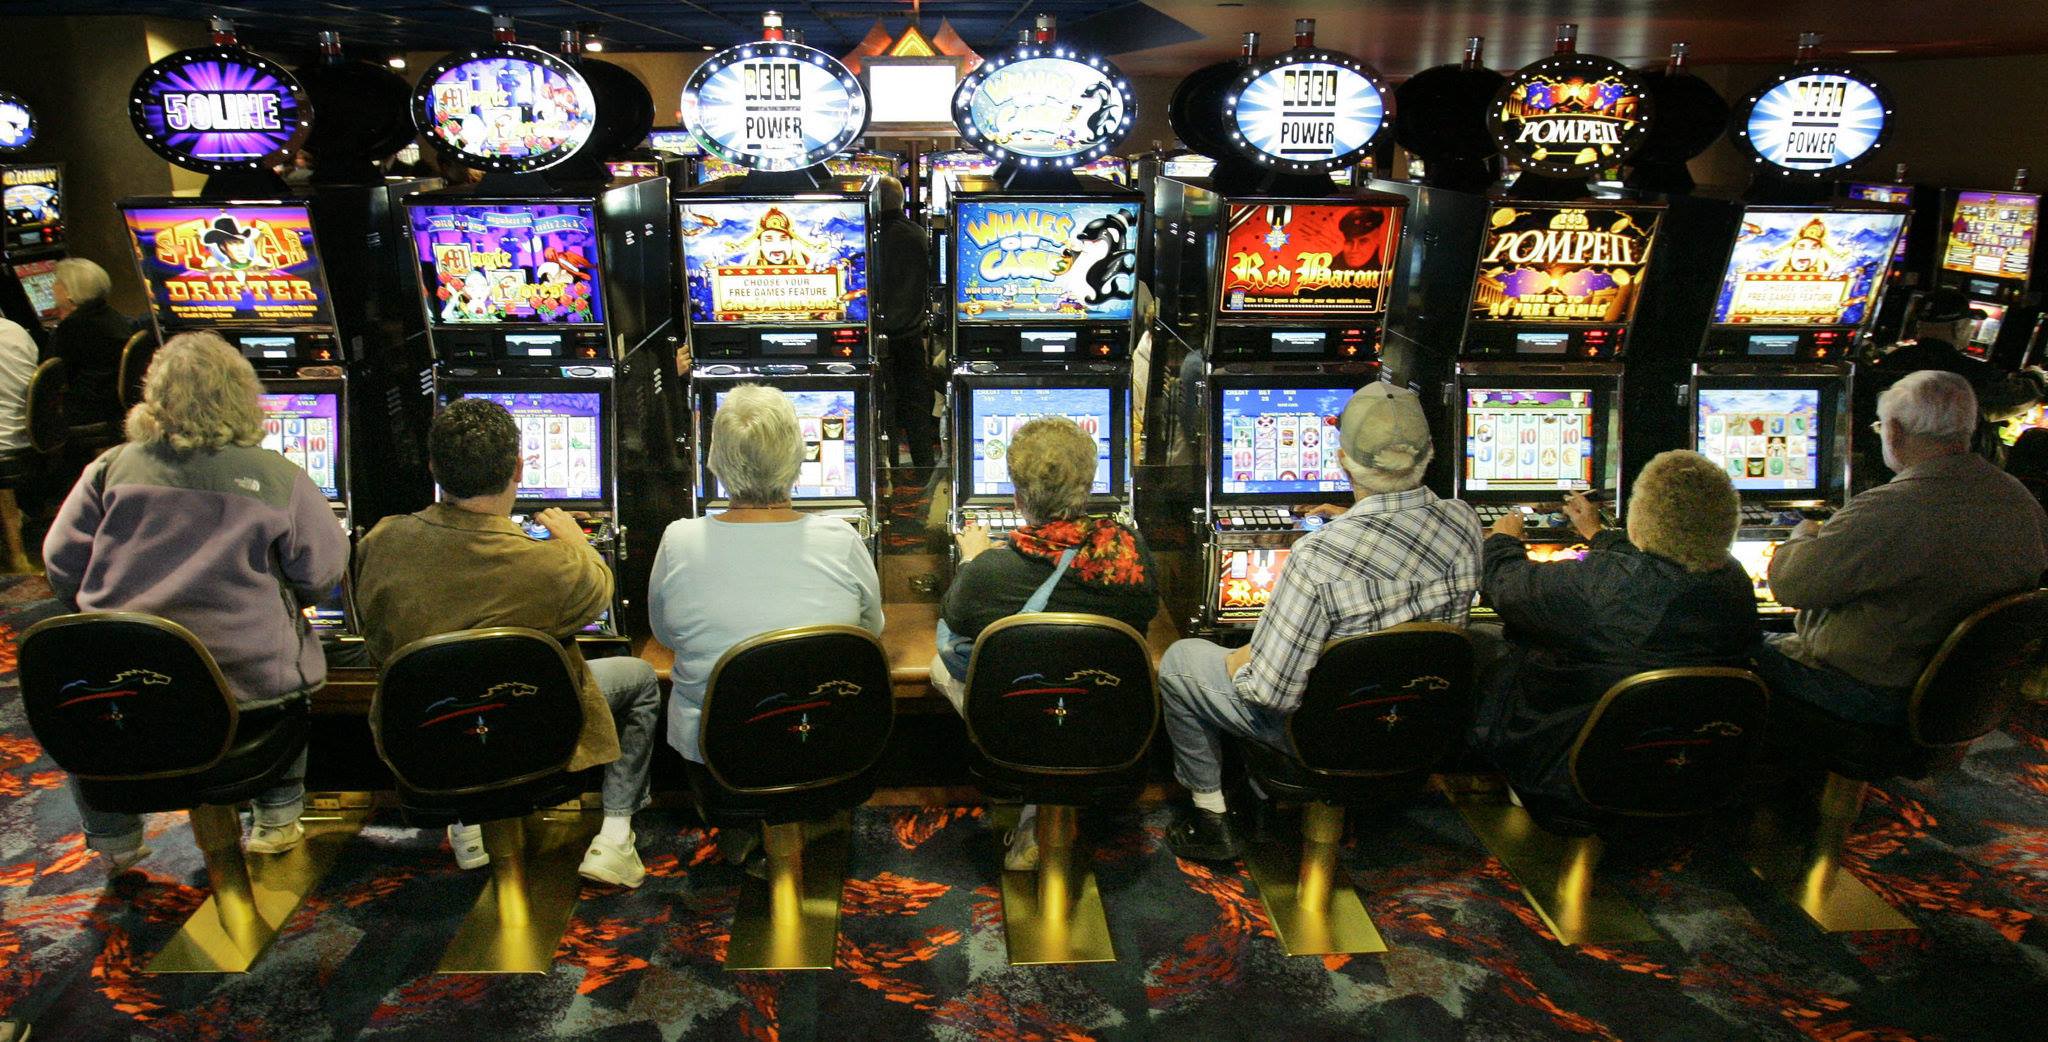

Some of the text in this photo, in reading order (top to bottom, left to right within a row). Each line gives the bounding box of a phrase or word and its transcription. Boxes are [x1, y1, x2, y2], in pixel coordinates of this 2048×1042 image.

[1283, 70, 1338, 106] REEL
[746, 116, 803, 139] POWER
[1281, 122, 1335, 144] POWER
[1515, 119, 1621, 144] POMPEII
[1786, 132, 1837, 154] POWER
[967, 208, 1075, 248] WHALES
[1000, 235, 1041, 251] OF
[1481, 230, 1637, 265] POMPEII
[442, 248, 513, 275] Magic
[743, 278, 811, 287] CHOOSE YOUR
[1228, 251, 1381, 296] Red Baron
[164, 279, 319, 302] DRIFTER
[729, 287, 828, 297] FREE GAMES FEATURE
[1513, 303, 1550, 316] FREE
[1553, 302, 1611, 317] GAMES
[309, 437, 326, 452] 10
[1519, 428, 1536, 444] 10
[1562, 428, 1579, 444] 10
